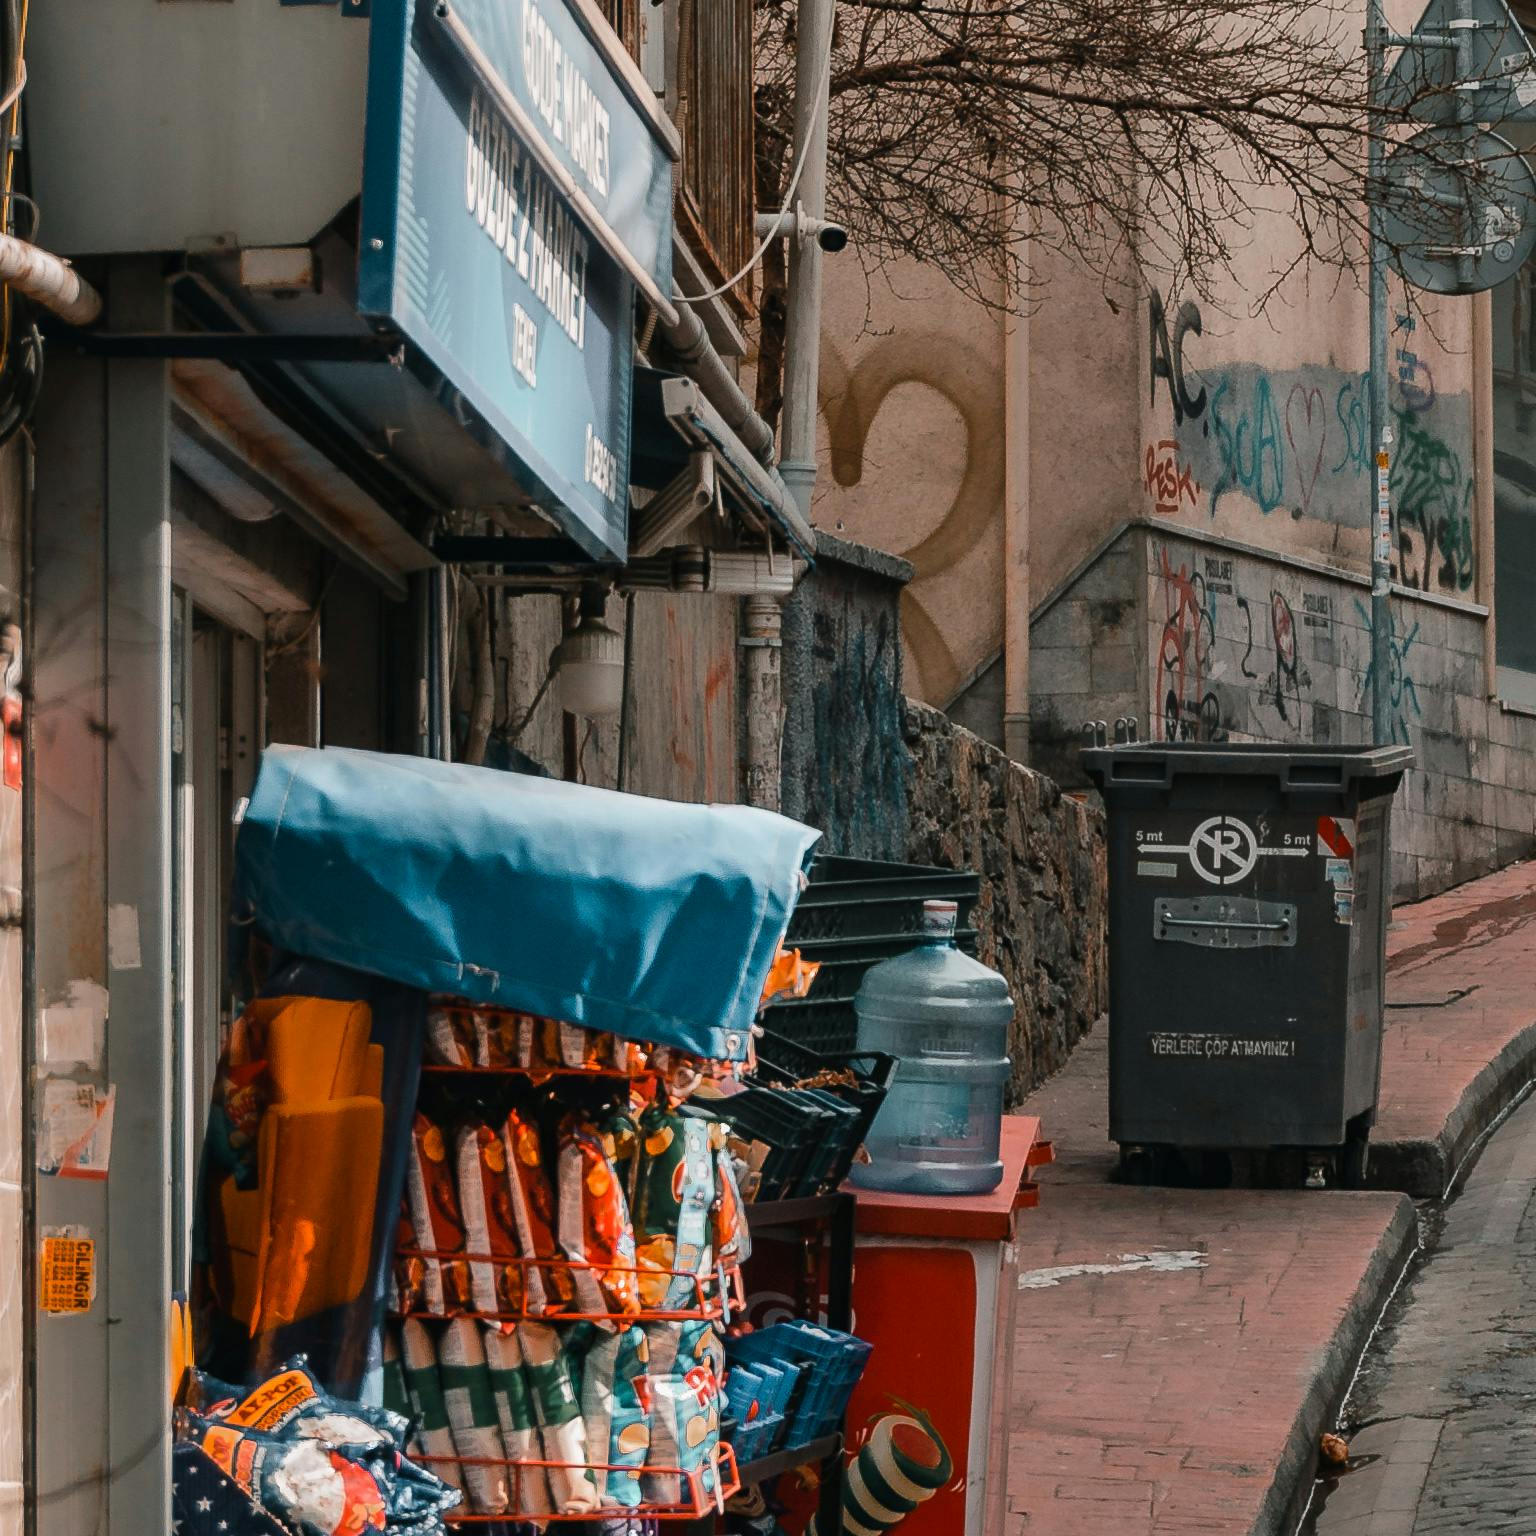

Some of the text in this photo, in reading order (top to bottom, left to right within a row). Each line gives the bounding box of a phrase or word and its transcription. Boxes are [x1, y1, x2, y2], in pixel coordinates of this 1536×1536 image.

[516, 157, 530, 282] 2
[530, 172, 588, 352] MARKET
[1135, 831, 1144, 841] 5
[1146, 831, 1163, 842] mt
[1284, 834, 1292, 845] 5
[1294, 834, 1311, 845] mt
[1151, 1038, 1203, 1054] YERLERE
[1205, 1036, 1229, 1058] ÇÖP
